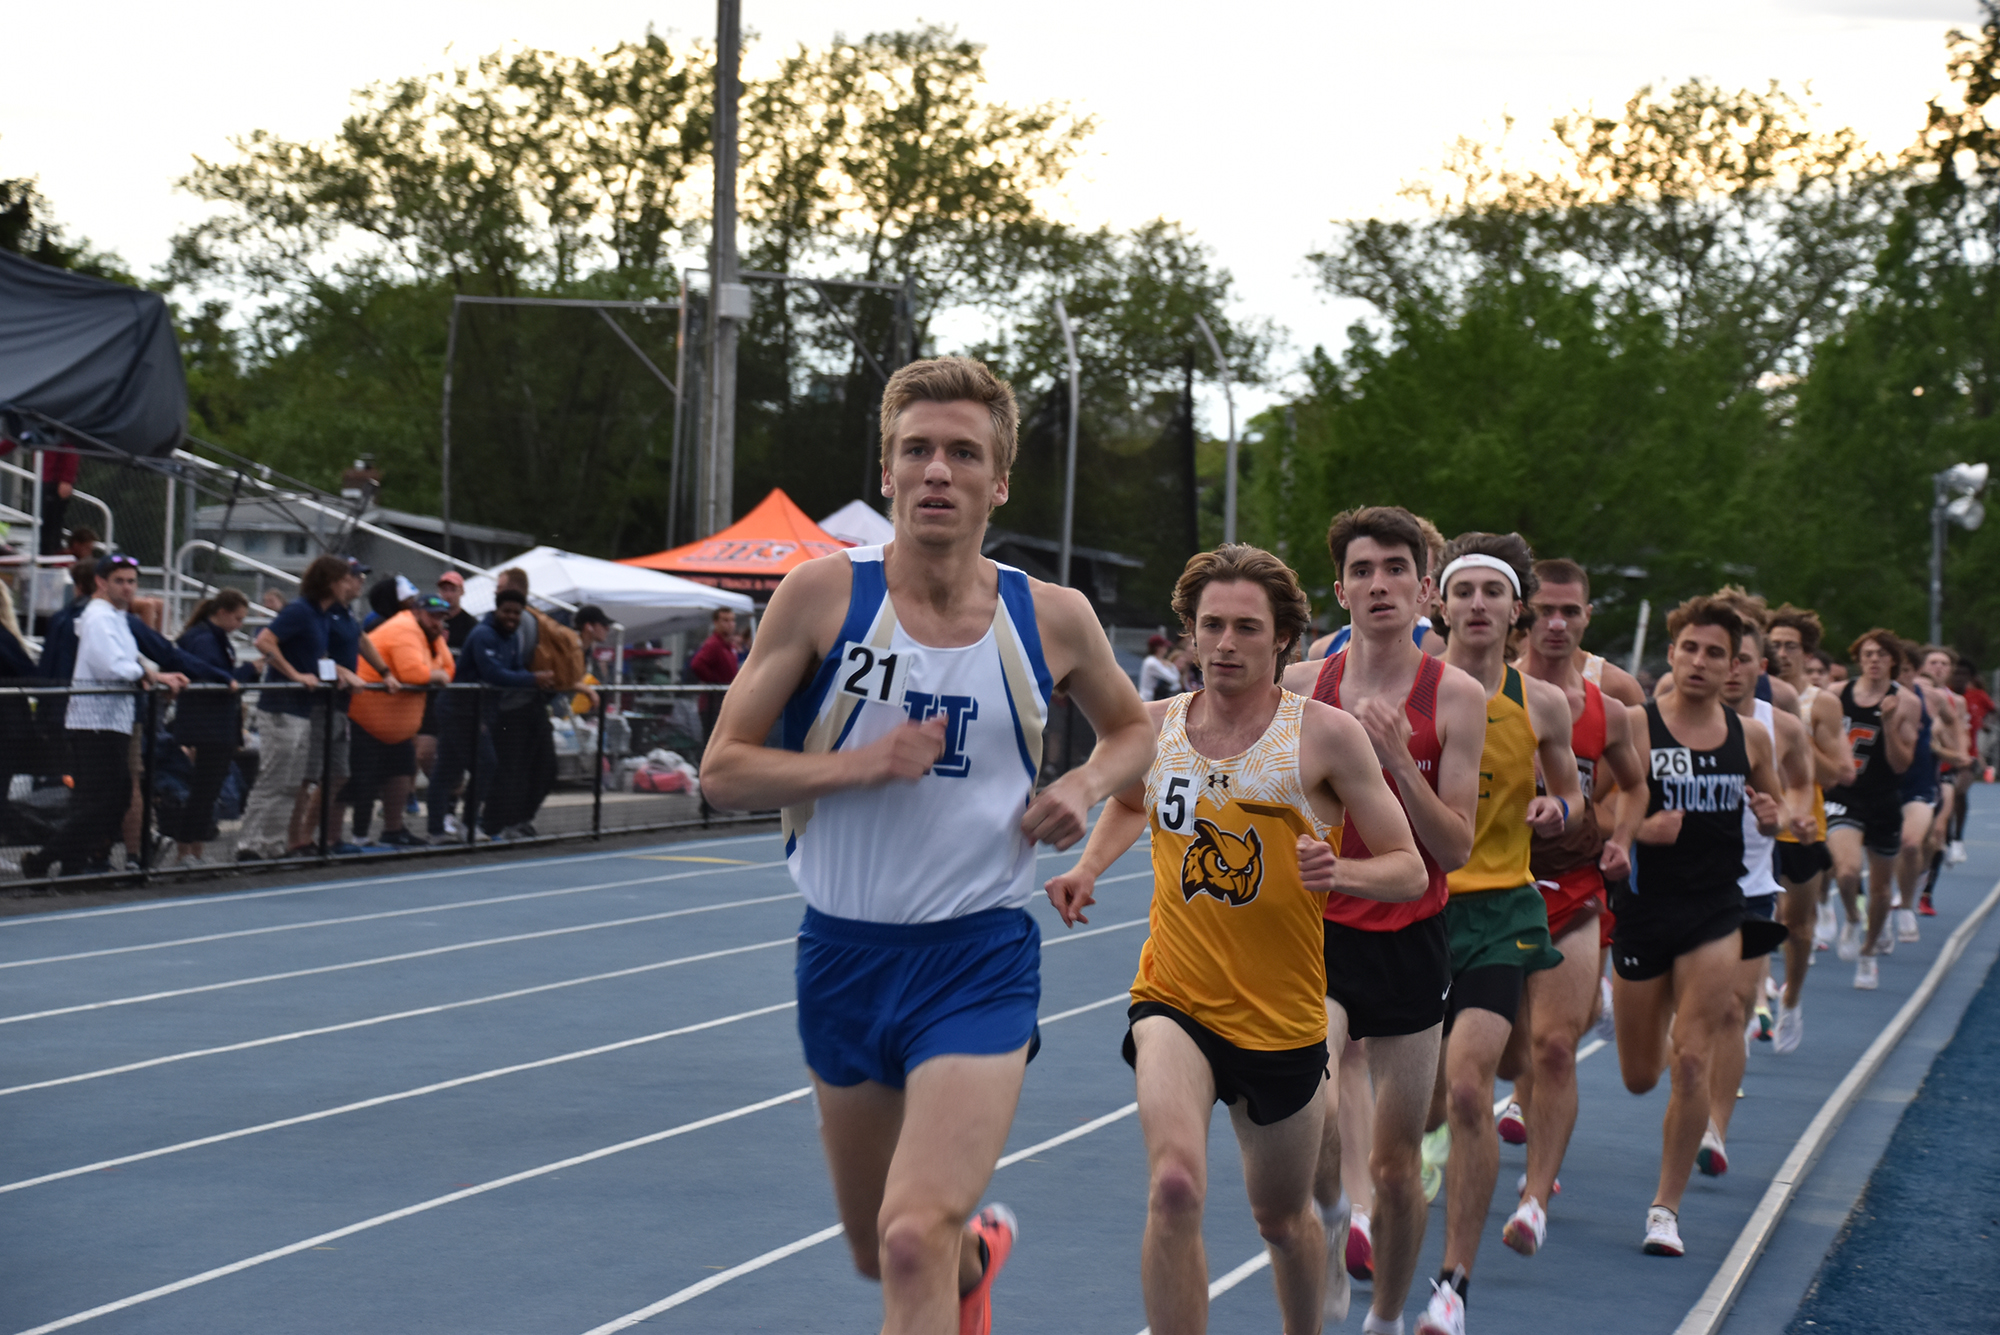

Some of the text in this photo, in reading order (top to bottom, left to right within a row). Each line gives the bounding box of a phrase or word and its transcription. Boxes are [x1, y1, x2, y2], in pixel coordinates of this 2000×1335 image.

[843, 646, 898, 702] 21
[1655, 751, 1688, 777] 26
[1163, 776, 1191, 831] 5
